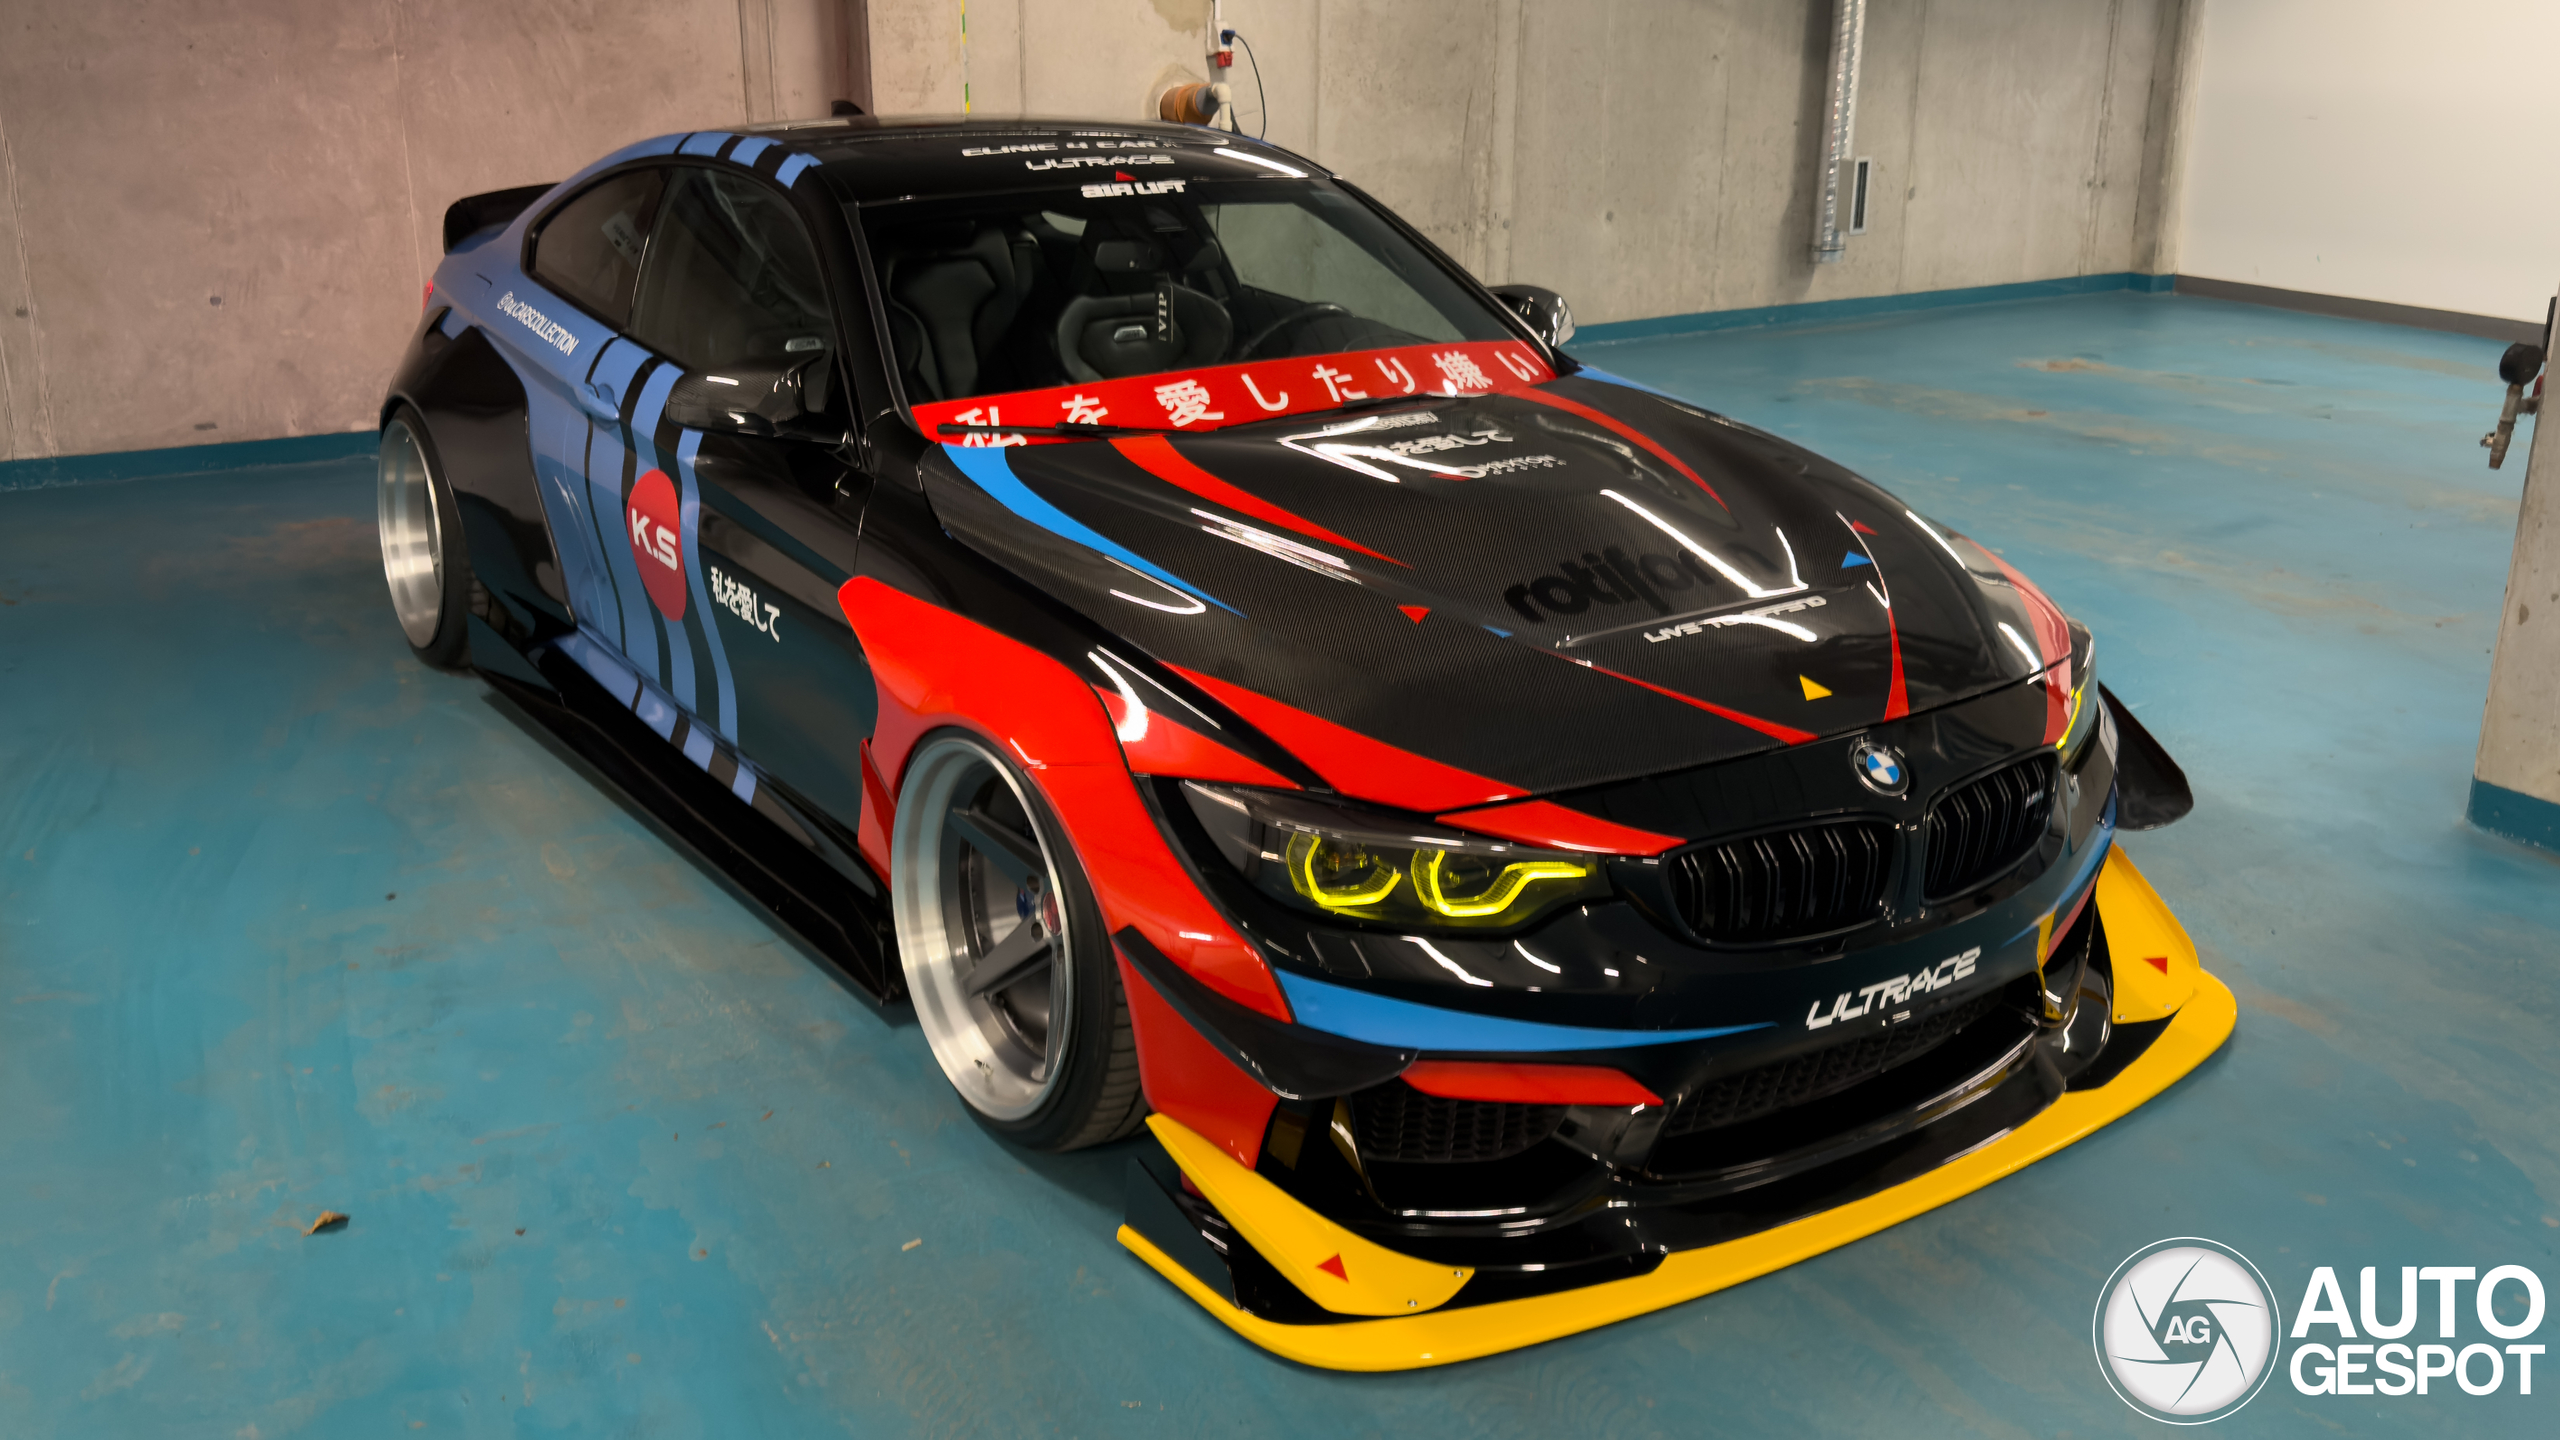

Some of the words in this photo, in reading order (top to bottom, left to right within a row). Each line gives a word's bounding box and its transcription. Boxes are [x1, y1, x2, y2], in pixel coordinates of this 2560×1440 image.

[1025, 154, 1175, 171] ULTRACE
[1134, 179, 1187, 196] LIFT
[1370, 429, 1515, 460] を愛して
[631, 507, 678, 571] K.S
[710, 565, 780, 643] 私を愛して
[1805, 945, 1982, 1031] ULTRACE
